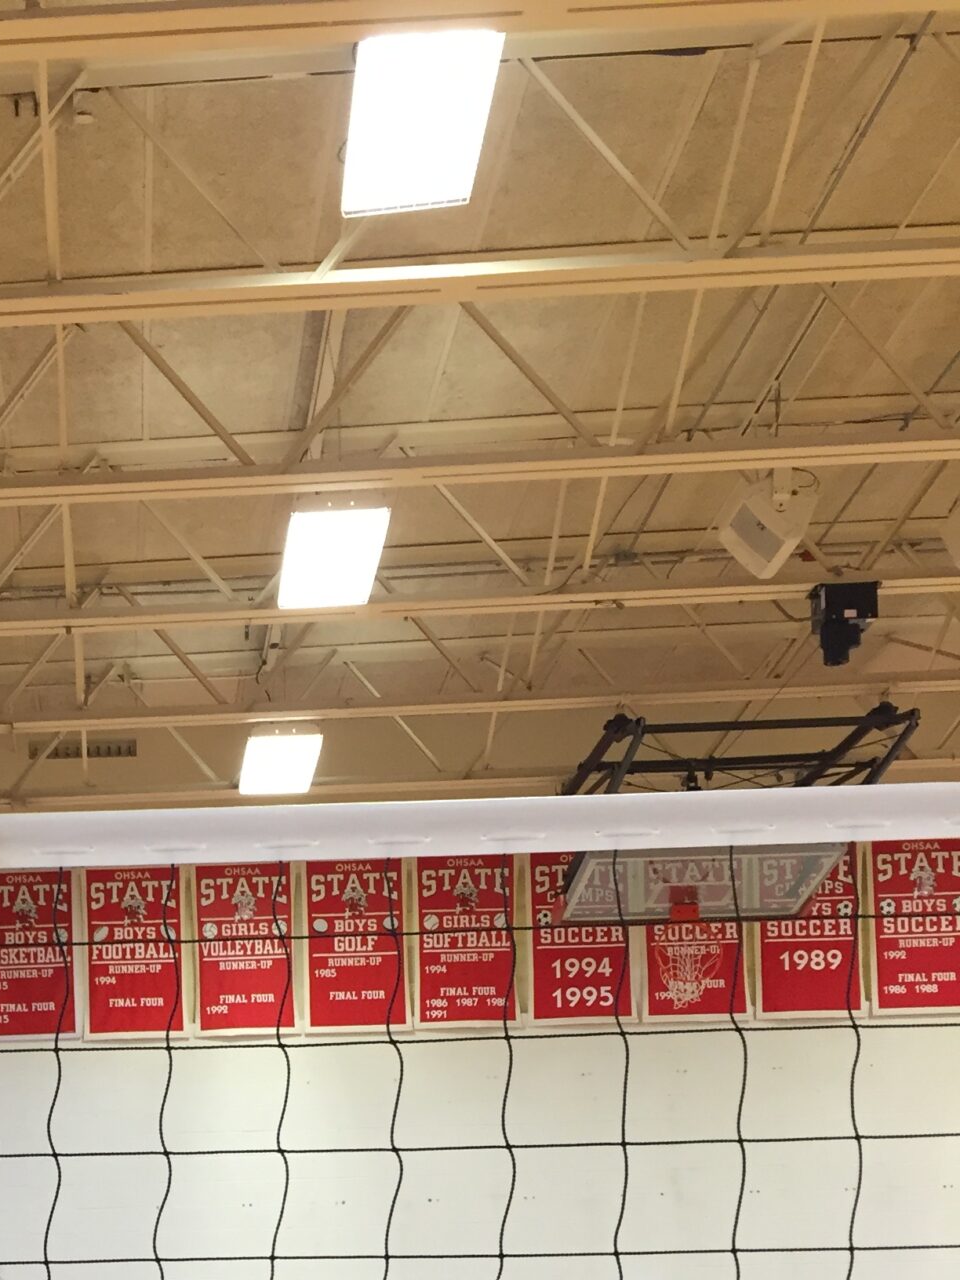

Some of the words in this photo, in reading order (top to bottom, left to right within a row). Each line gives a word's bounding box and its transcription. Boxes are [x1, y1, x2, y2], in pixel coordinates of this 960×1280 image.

[336, 862, 371, 871] OHSAA
[447, 858, 484, 867] OHSAA
[115, 872, 150, 881] OHSAA
[225, 867, 261, 876] OHSAA
[6, 875, 42, 884] OHSAA
[422, 867, 509, 896] STATE
[201, 876, 287, 906] STATE
[311, 871, 398, 902] STATE
[91, 880, 176, 910] STATE
[902, 899, 946, 913] BOYS
[334, 918, 377, 933] BOYS
[443, 914, 490, 928] GIRLS
[114, 927, 156, 940] BOYS
[222, 922, 268, 936] GIRLS
[767, 920, 852, 936] SOCCER
[5, 931, 47, 944] BOYS
[423, 930, 510, 948] SOFTBALL
[540, 926, 623, 943] SOCCER
[201, 937, 289, 956] VOLLEYBALL
[334, 935, 378, 952] GOLF
[899, 938, 955, 948] RUNNER-UP
[92, 942, 178, 960] FOOTBALL
[884, 951, 906, 959] 1992
[328, 957, 382, 967] RUNNER-UP
[440, 952, 494, 963] RUNNER-UP
[779, 950, 842, 970] 1989
[109, 964, 162, 975] RUNNER-UP
[219, 960, 273, 971] RUNNER-UP
[425, 965, 446, 974] 1994
[552, 958, 612, 978] 1994
[0, 969, 53, 980] RUNNER-UP
[314, 969, 336, 978] 1985
[898, 973, 928, 982] FINAL
[932, 972, 956, 981] FOUR
[95, 976, 116, 985] 1994
[329, 990, 358, 1000] FINAL
[361, 990, 385, 999] FOUR
[440, 987, 469, 996] FINAL
[472, 986, 496, 995] FOUR
[109, 998, 137, 1007] FINAL
[141, 998, 164, 1007] FOUR
[219, 994, 248, 1004] FINAL
[251, 994, 275, 1003] FOUR
[456, 998, 478, 1007] 1987
[552, 988, 614, 1007] 1995
[0, 1003, 29, 1013] FINAL
[32, 1002, 55, 1011] FOUR
[206, 1005, 228, 1015] 1992
